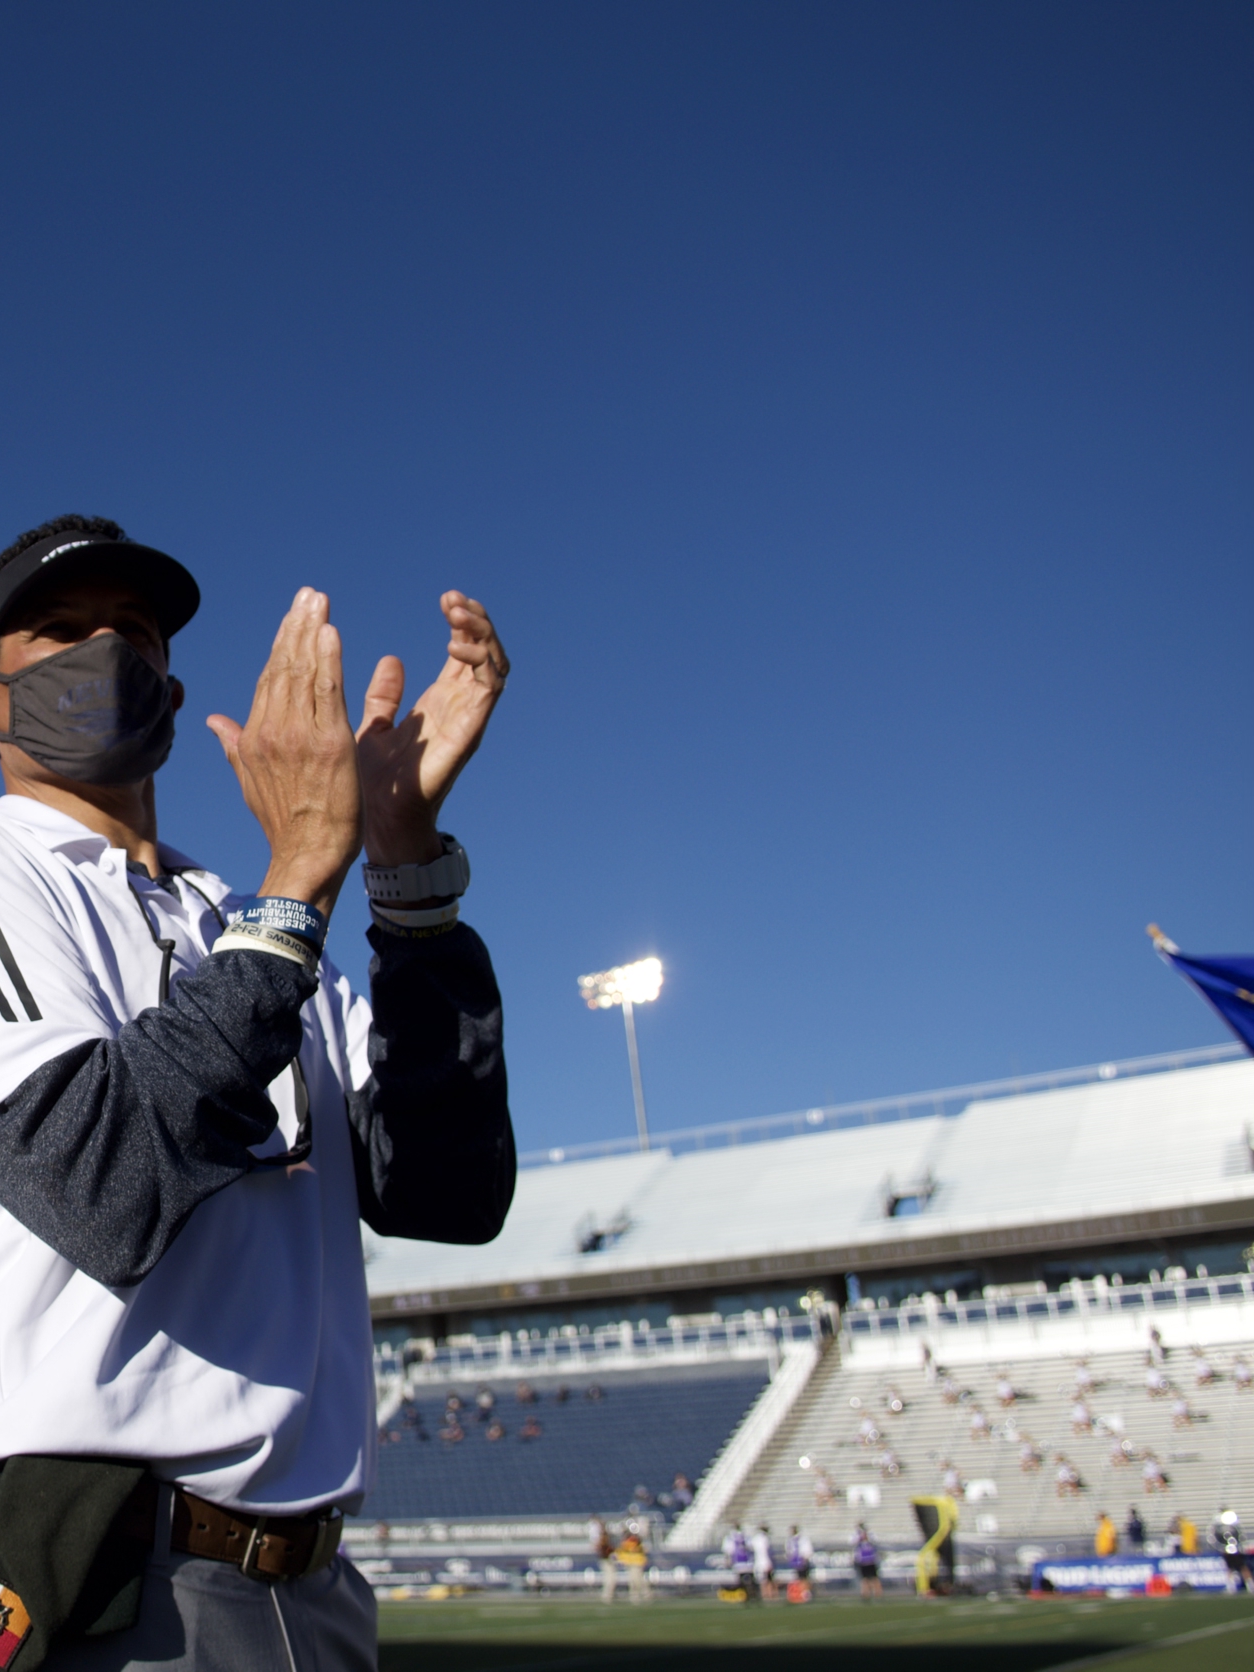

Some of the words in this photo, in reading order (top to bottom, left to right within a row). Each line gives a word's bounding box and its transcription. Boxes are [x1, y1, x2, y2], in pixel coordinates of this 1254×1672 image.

[265, 899, 306, 912] HUSTLE
[259, 916, 306, 931] RESPECT
[266, 931, 314, 962] Hebrews
